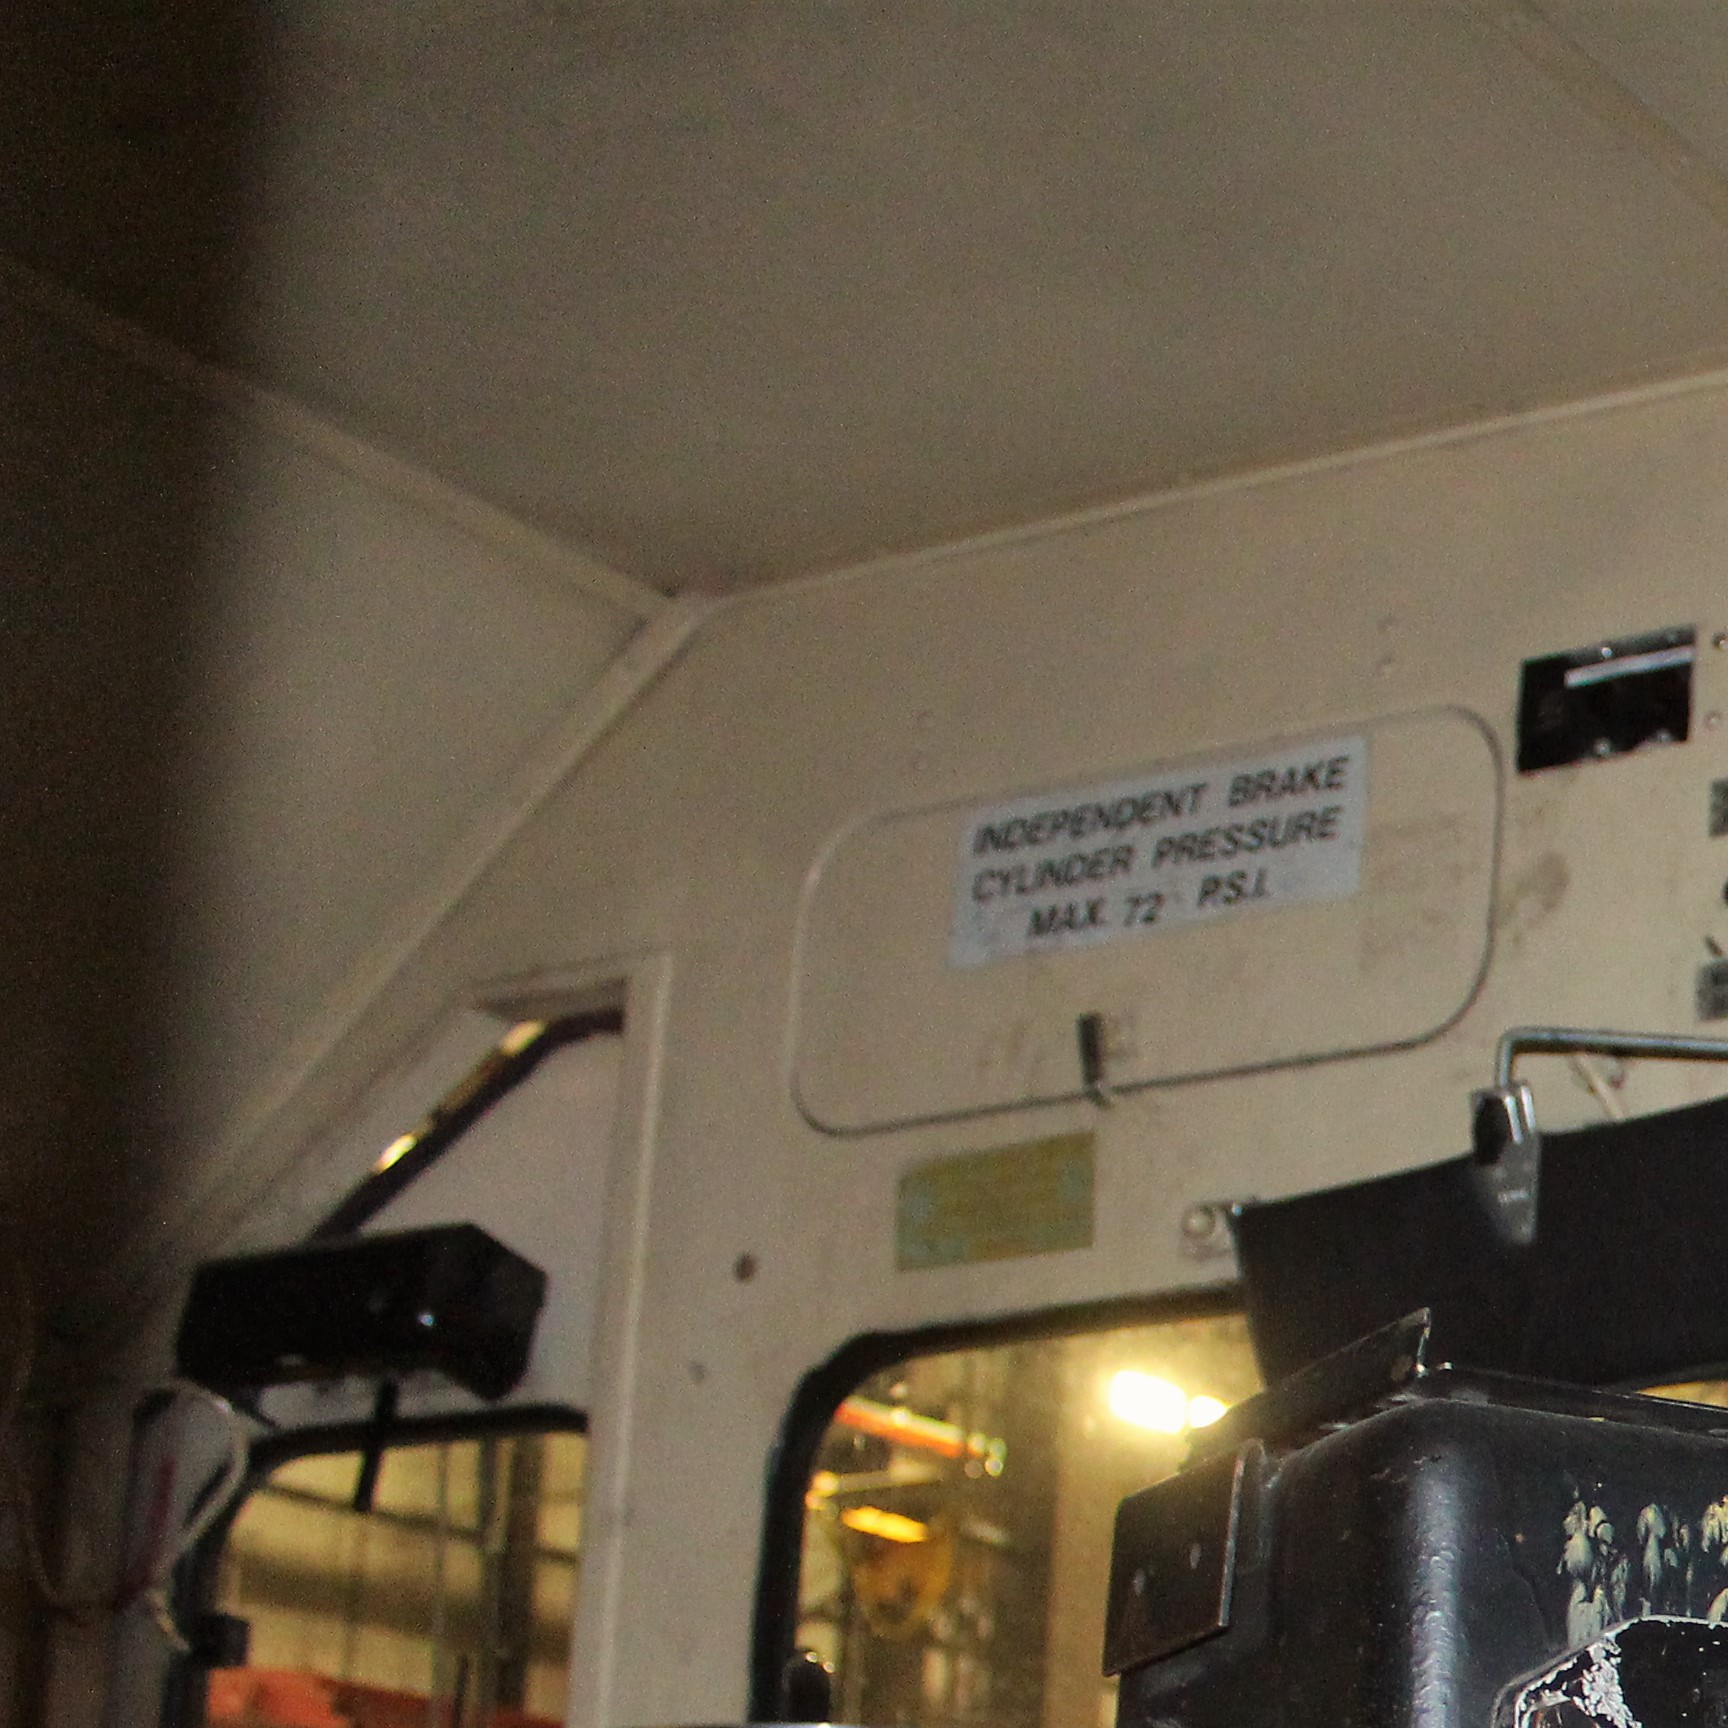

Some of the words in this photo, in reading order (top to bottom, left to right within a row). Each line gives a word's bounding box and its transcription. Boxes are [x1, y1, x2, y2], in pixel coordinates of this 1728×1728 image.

[971, 844, 1135, 903] CYLINDER
[1151, 805, 1343, 868] PRESSURE
[972, 782, 1209, 857] INDEPENDENT
[1227, 755, 1350, 807] BRAKE
[1124, 893, 1164, 926] 72
